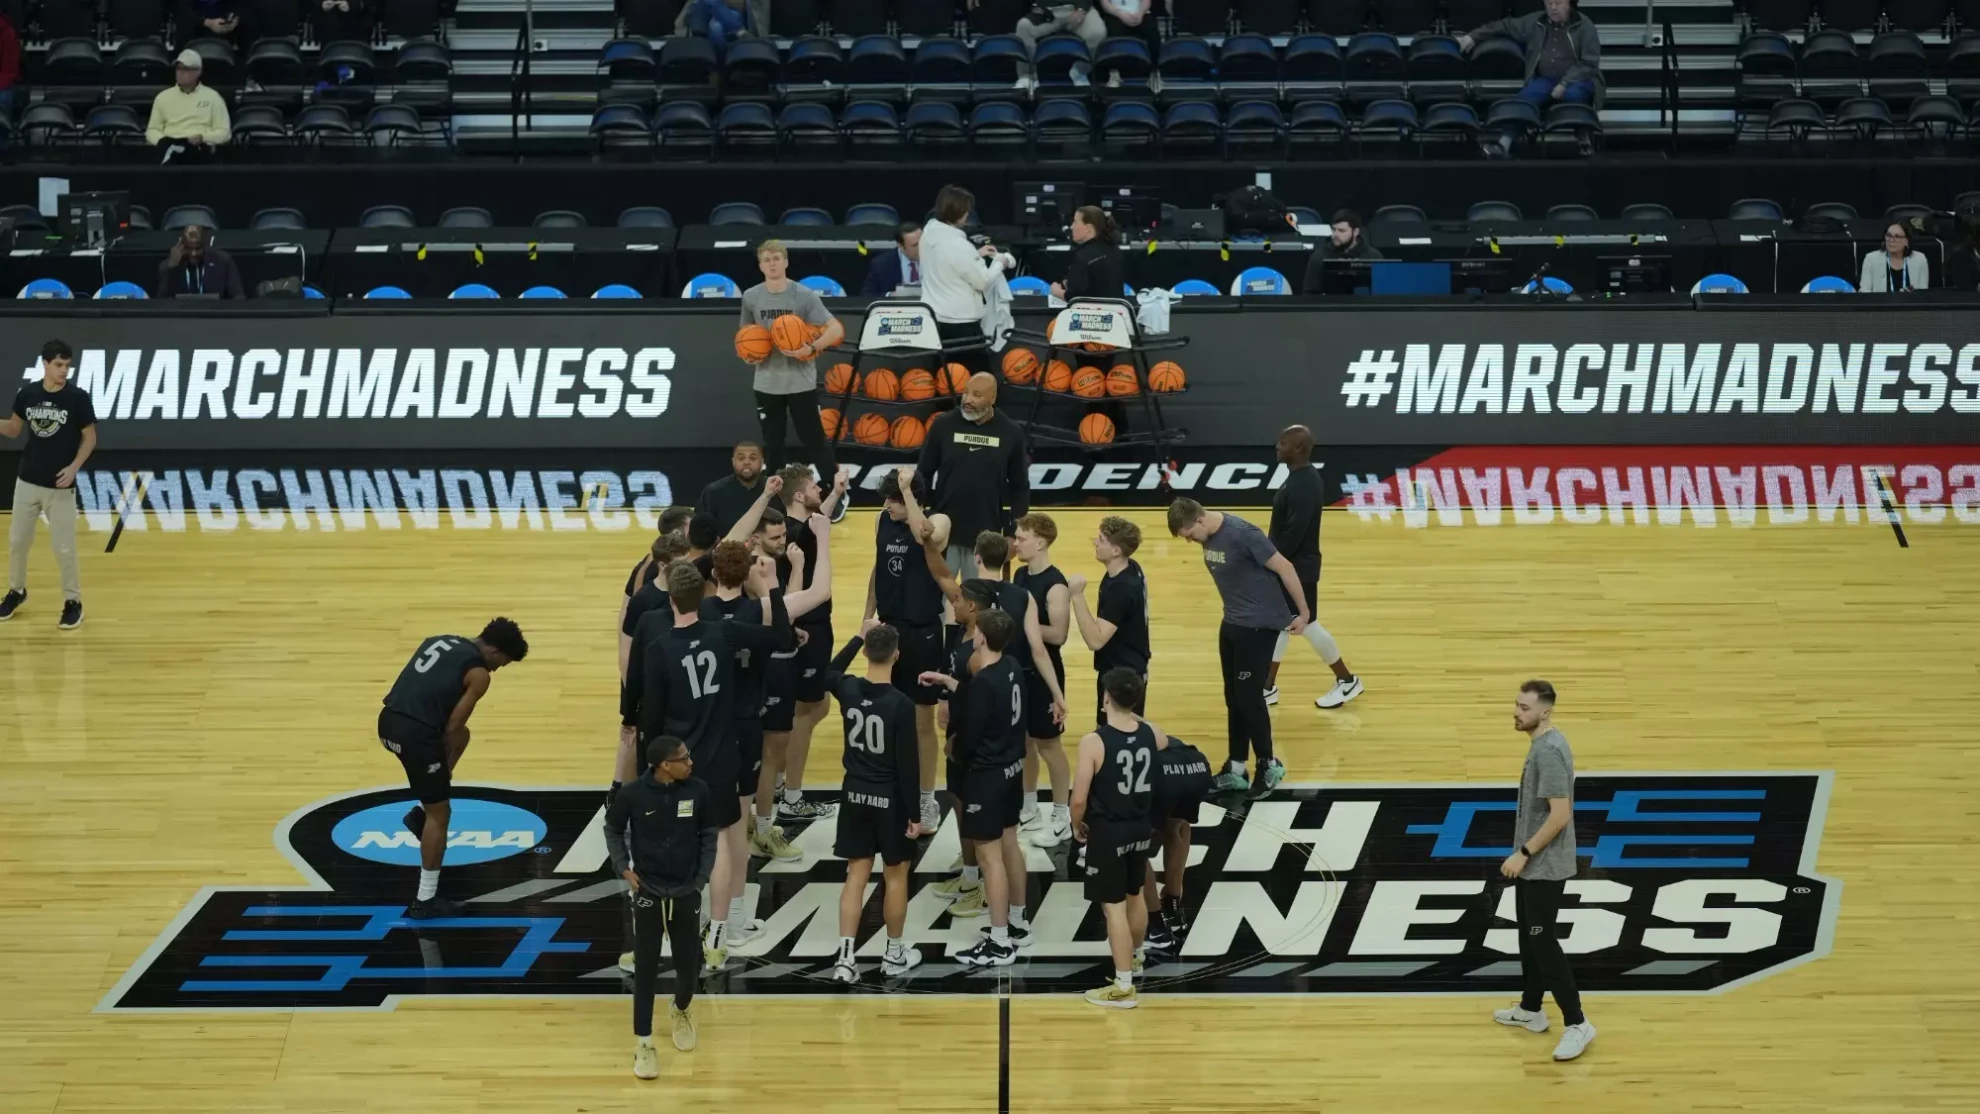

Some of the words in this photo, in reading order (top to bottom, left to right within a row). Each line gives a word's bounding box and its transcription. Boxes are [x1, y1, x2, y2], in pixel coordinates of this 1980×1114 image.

[888, 318, 911, 326] MARCH
[1079, 314, 1102, 323] MARCH
[891, 325, 922, 333] MADNESS
[1081, 322, 1112, 331] MADNESS
[25, 406, 68, 424] CHAMPIONS
[963, 435, 990, 445] PURDUE
[891, 559, 903, 572] 34
[414, 639, 453, 673] 5
[681, 650, 720, 699] 12
[1011, 684, 1022, 726] 9
[847, 707, 885, 755] 20
[1116, 747, 1151, 794] 32
[1163, 764, 1185, 775] PLAY
[848, 791, 868, 804] PLAY
[867, 795, 889, 809] HARD
